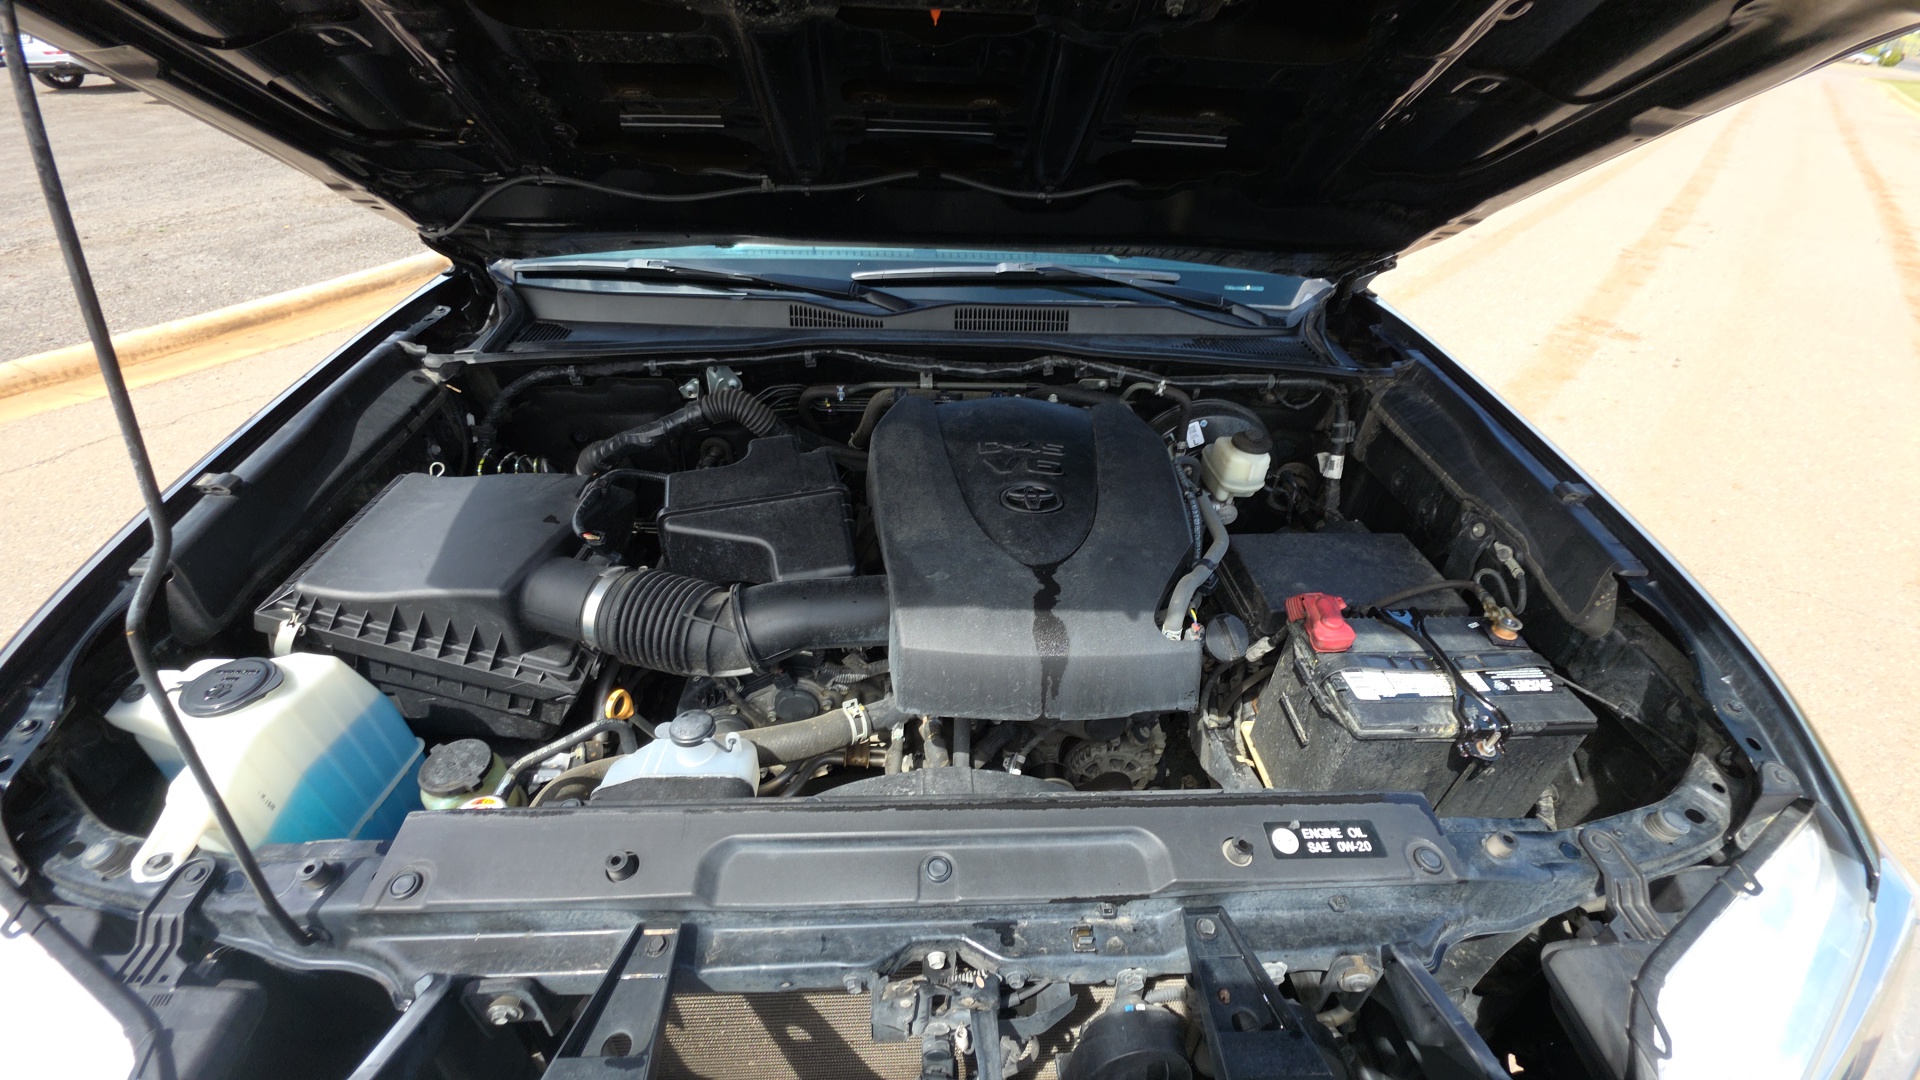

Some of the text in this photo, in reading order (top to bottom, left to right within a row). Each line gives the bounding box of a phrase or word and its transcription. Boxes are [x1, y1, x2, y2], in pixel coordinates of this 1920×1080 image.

[982, 457, 1064, 476] V6
[1301, 827, 1368, 839] ENGINE OIL
[1307, 840, 1373, 853] SAE 0W-20
